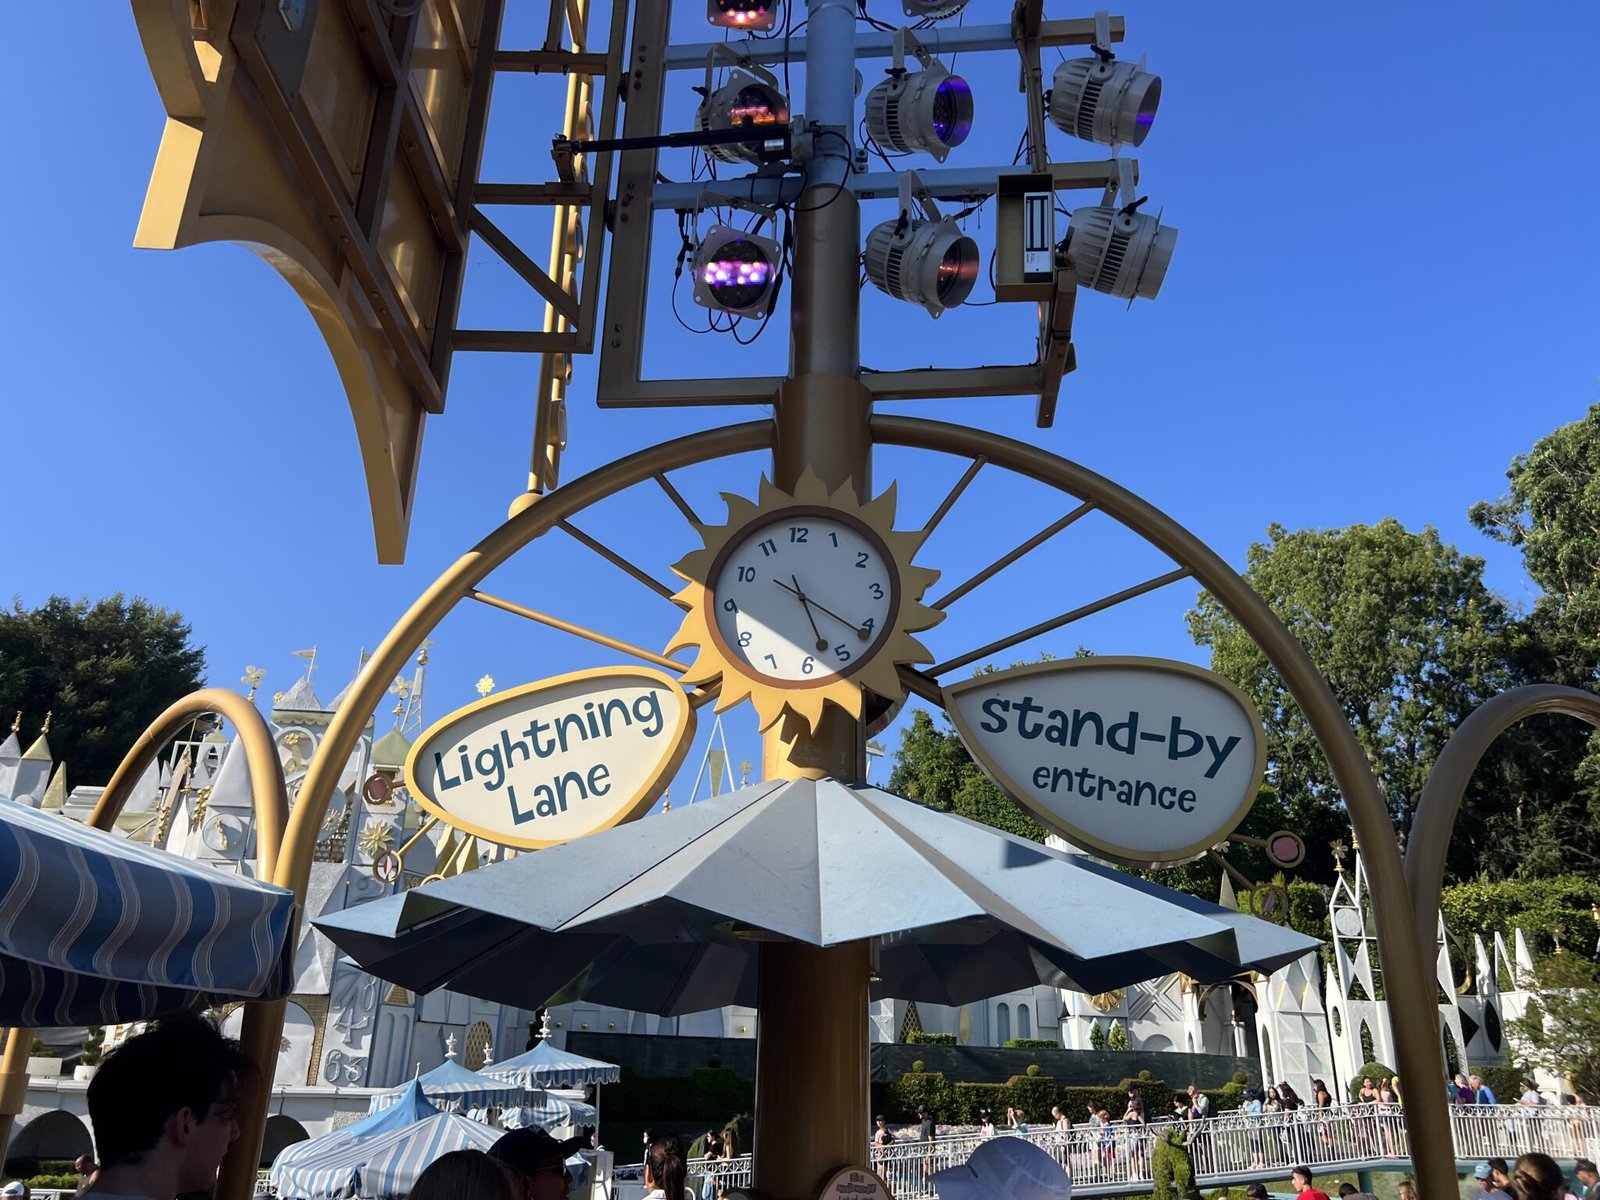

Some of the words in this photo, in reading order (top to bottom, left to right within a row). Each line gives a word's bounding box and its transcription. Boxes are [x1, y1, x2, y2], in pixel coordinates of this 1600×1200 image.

[789, 527, 809, 543] 12
[828, 532, 839, 548] 1
[758, 538, 778, 557] 11
[855, 552, 870, 569] 2
[737, 566, 756, 583] 10
[868, 583, 884, 600] 3
[723, 598, 739, 614] 9
[861, 617, 875, 635] 4
[737, 631, 752, 648] 8
[764, 653, 778, 670] 7
[834, 644, 851, 662] 5
[801, 656, 815, 675] 6
[434, 690, 664, 792] Lightning
[507, 763, 612, 826] Lane
[1032, 766, 1197, 813] entrance
